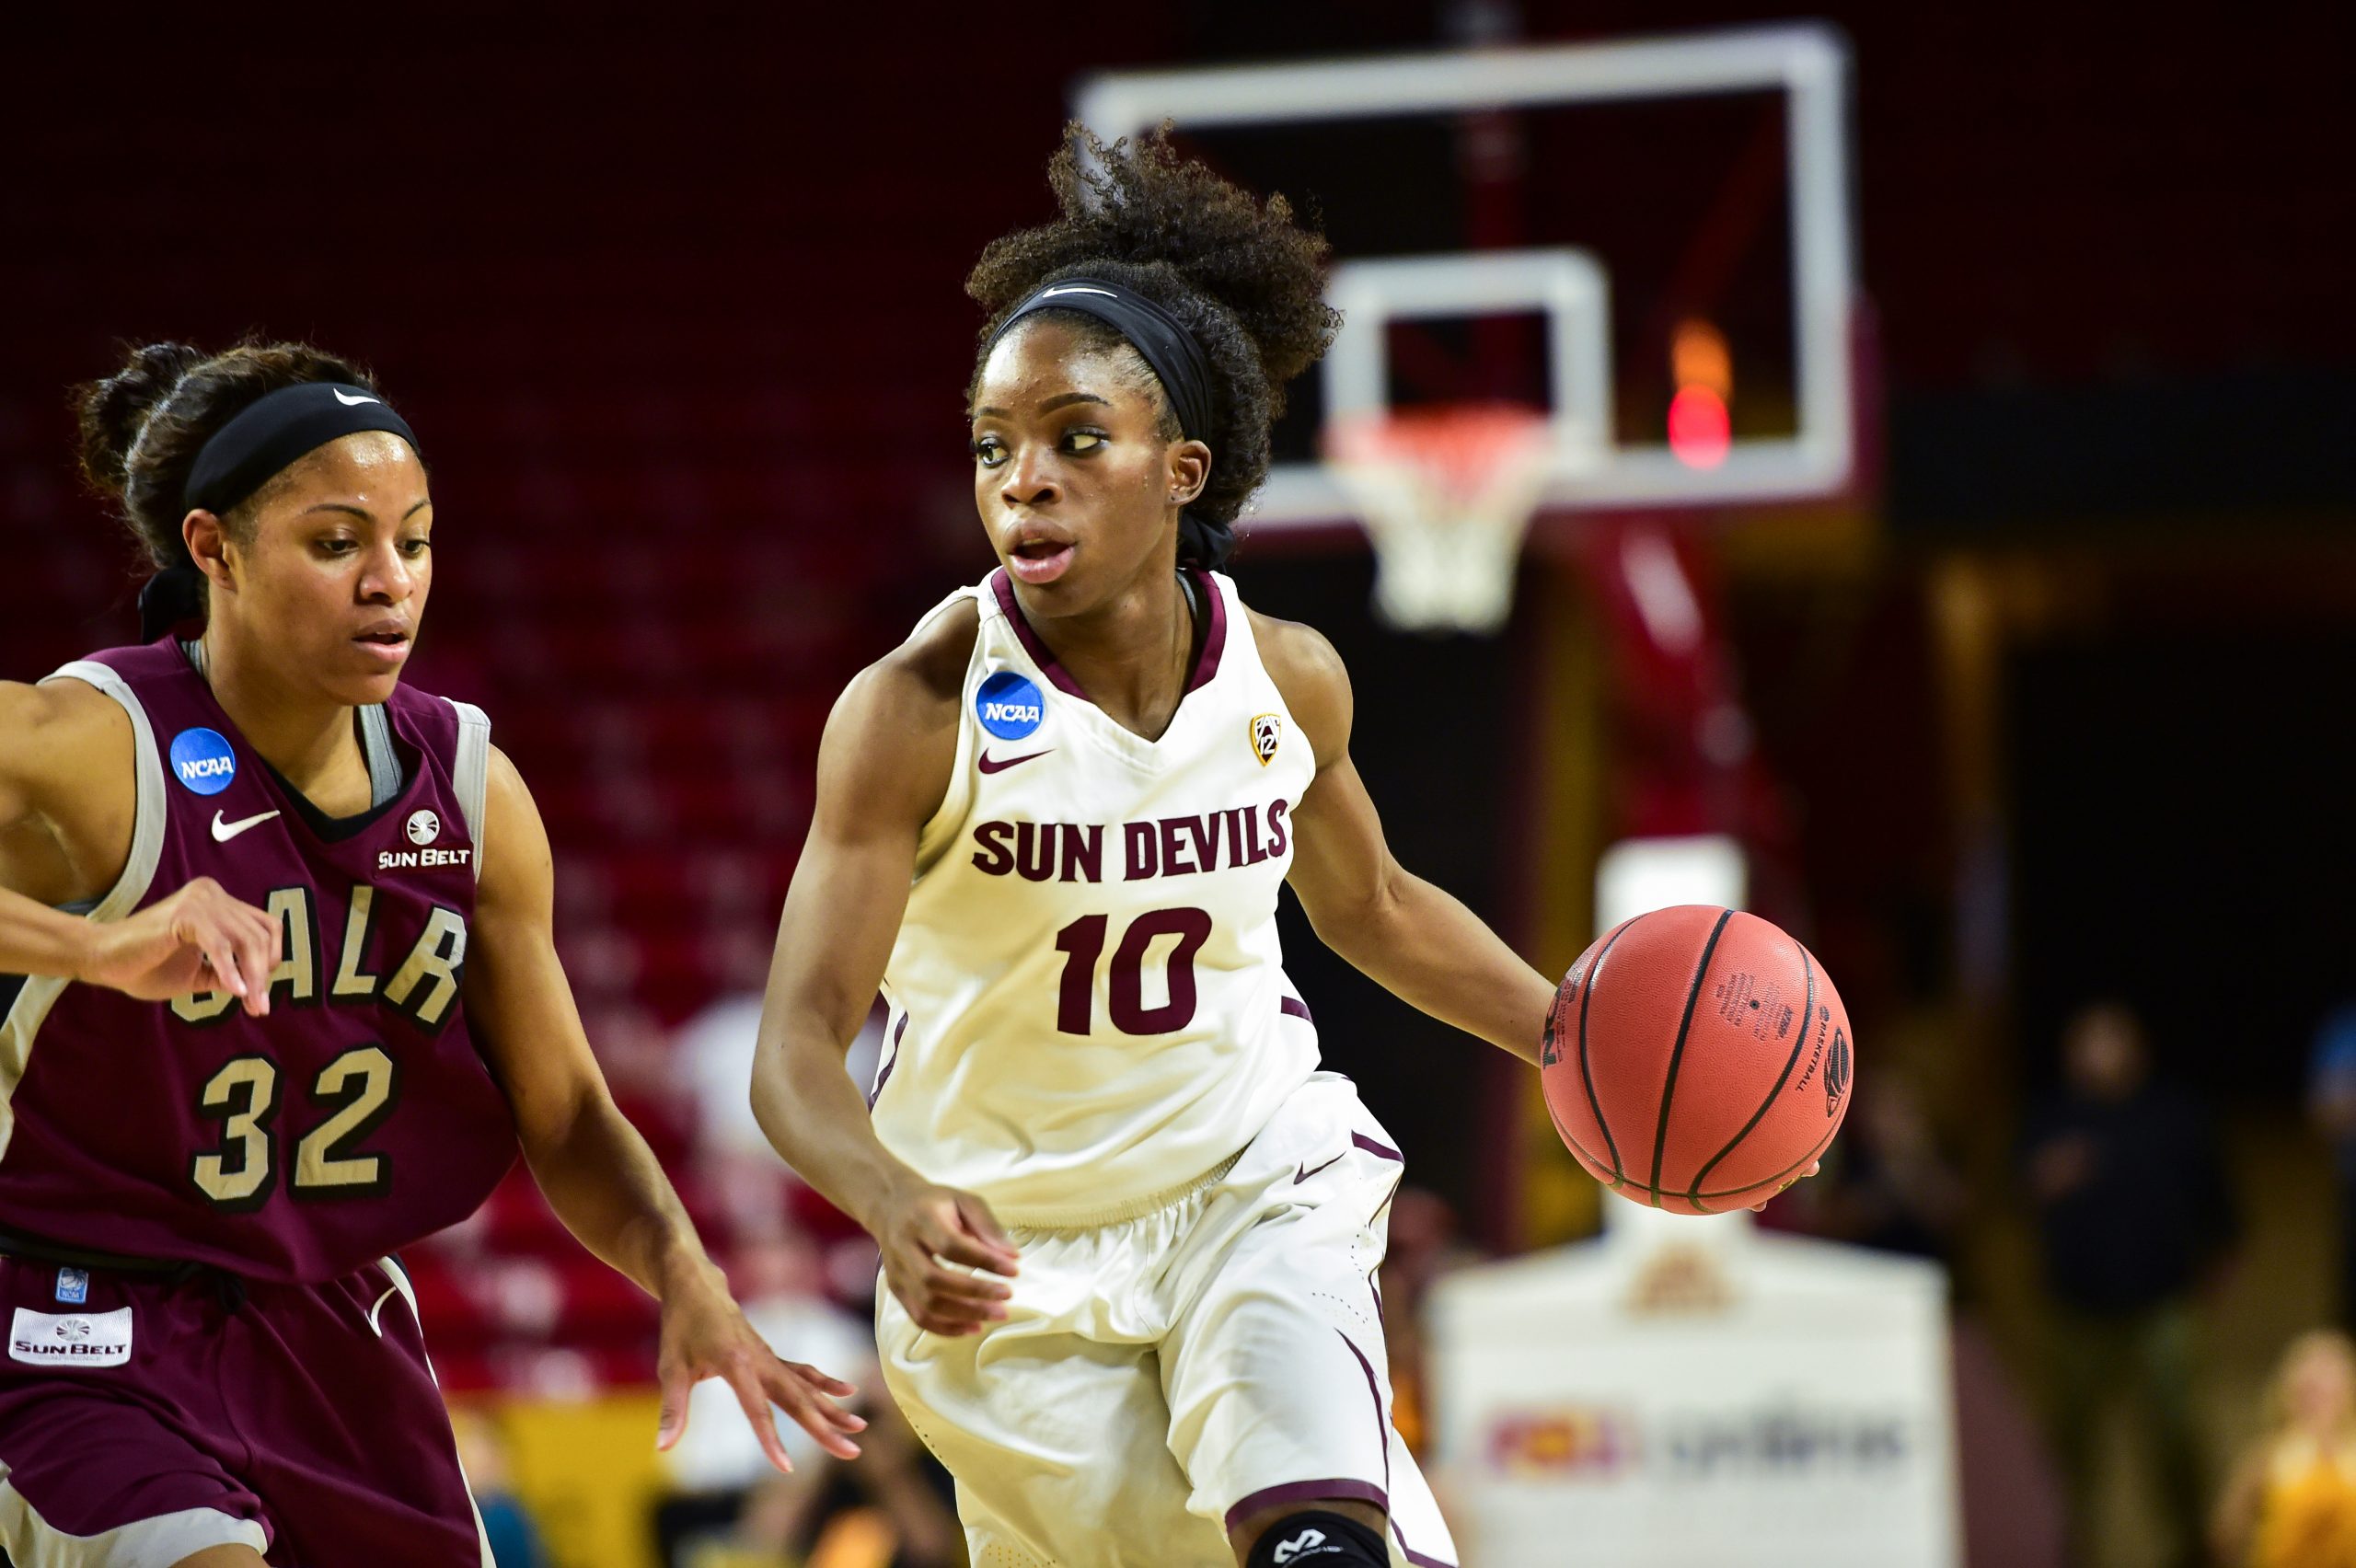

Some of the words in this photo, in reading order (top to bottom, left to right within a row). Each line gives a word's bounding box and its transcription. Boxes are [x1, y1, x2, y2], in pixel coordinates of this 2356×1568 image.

[985, 702, 1040, 723] NCAA
[1260, 734, 1276, 755] 12
[181, 755, 235, 779] NCAA
[971, 820, 1106, 883] SUN
[1123, 799, 1288, 882] DEVILS
[378, 851, 418, 870] SUN
[421, 848, 470, 867] BELT
[1055, 906, 1213, 1037] 10
[1795, 1020, 1828, 1092] BASKETBALL
[191, 1044, 396, 1204] 32
[15, 1341, 66, 1355] SUN
[70, 1343, 127, 1355] BELT
